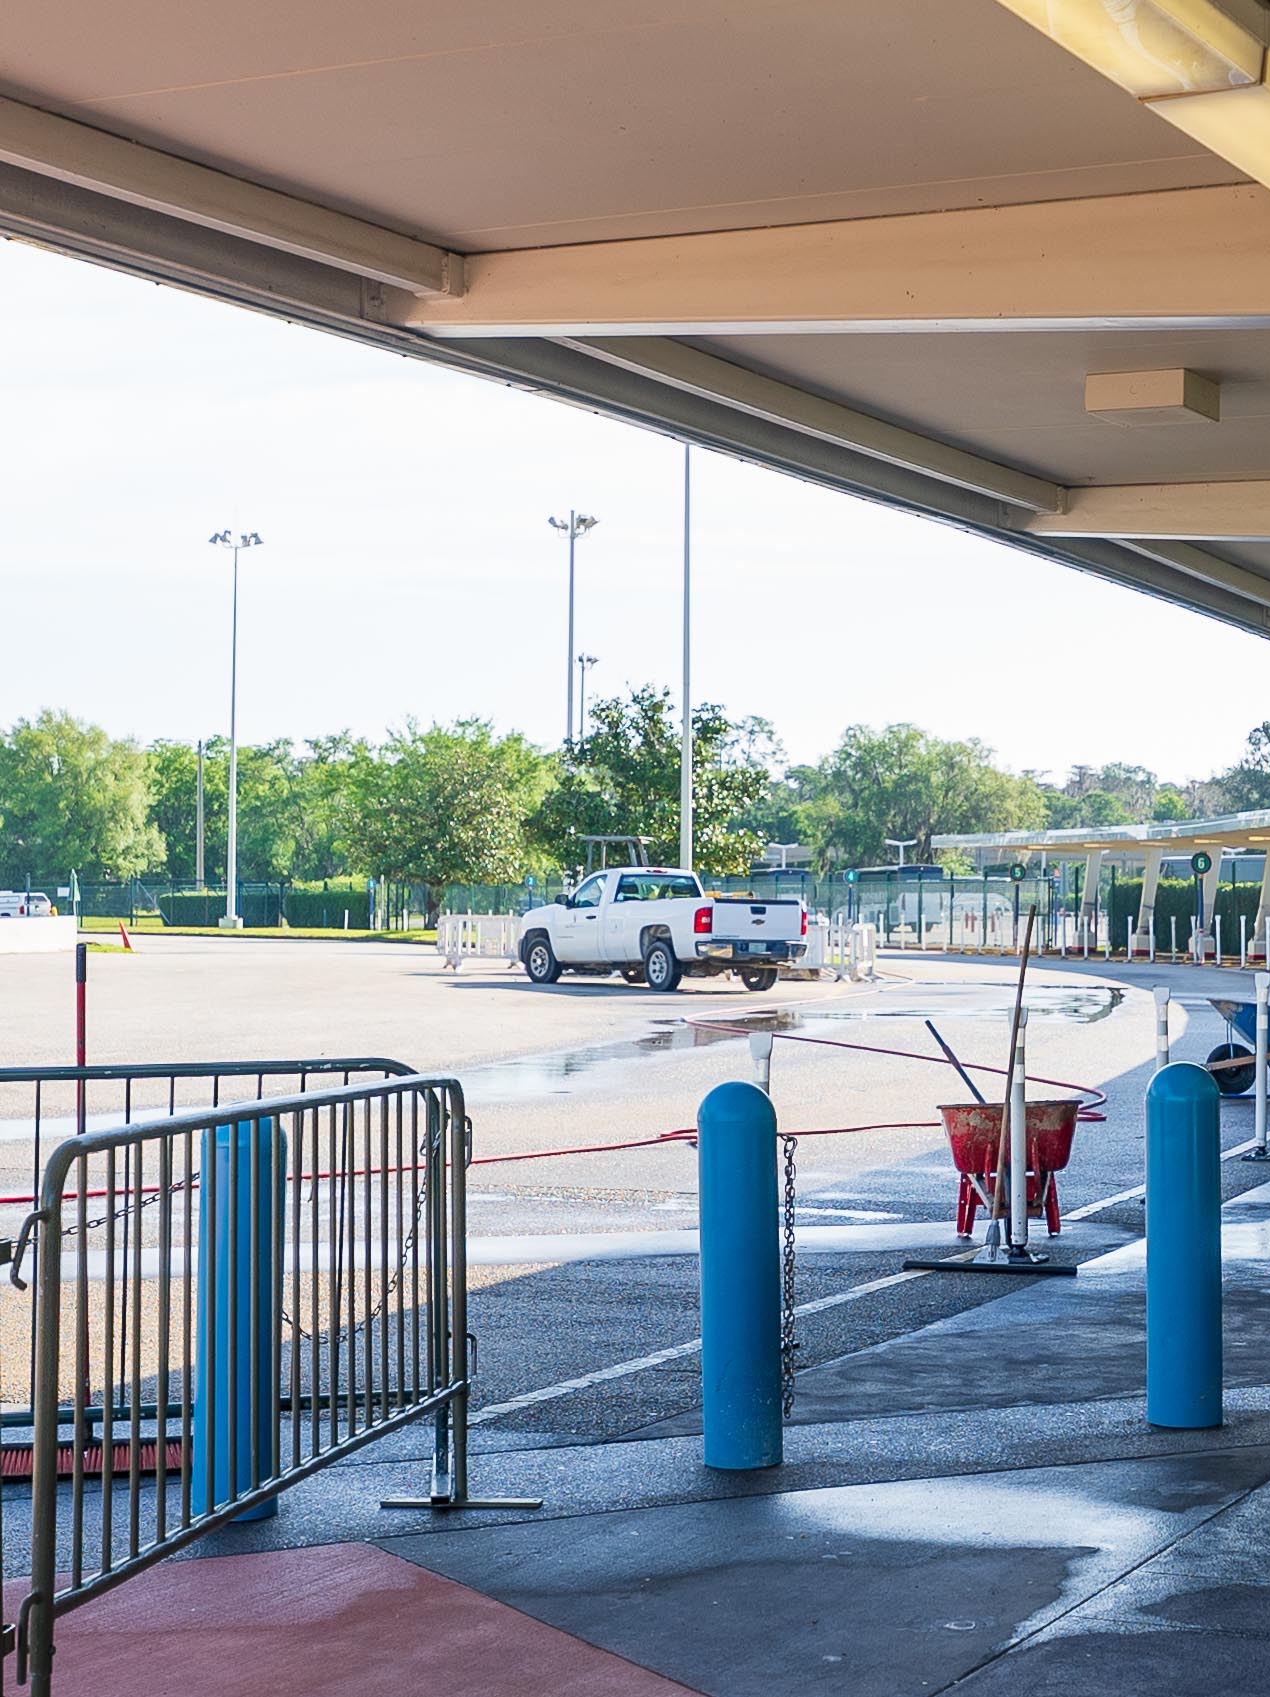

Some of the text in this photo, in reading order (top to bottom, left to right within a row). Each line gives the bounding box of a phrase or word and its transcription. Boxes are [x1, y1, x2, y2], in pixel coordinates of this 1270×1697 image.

[1197, 857, 1205, 869] 6
[848, 871, 854, 881] 4
[1014, 867, 1021, 878] 5
